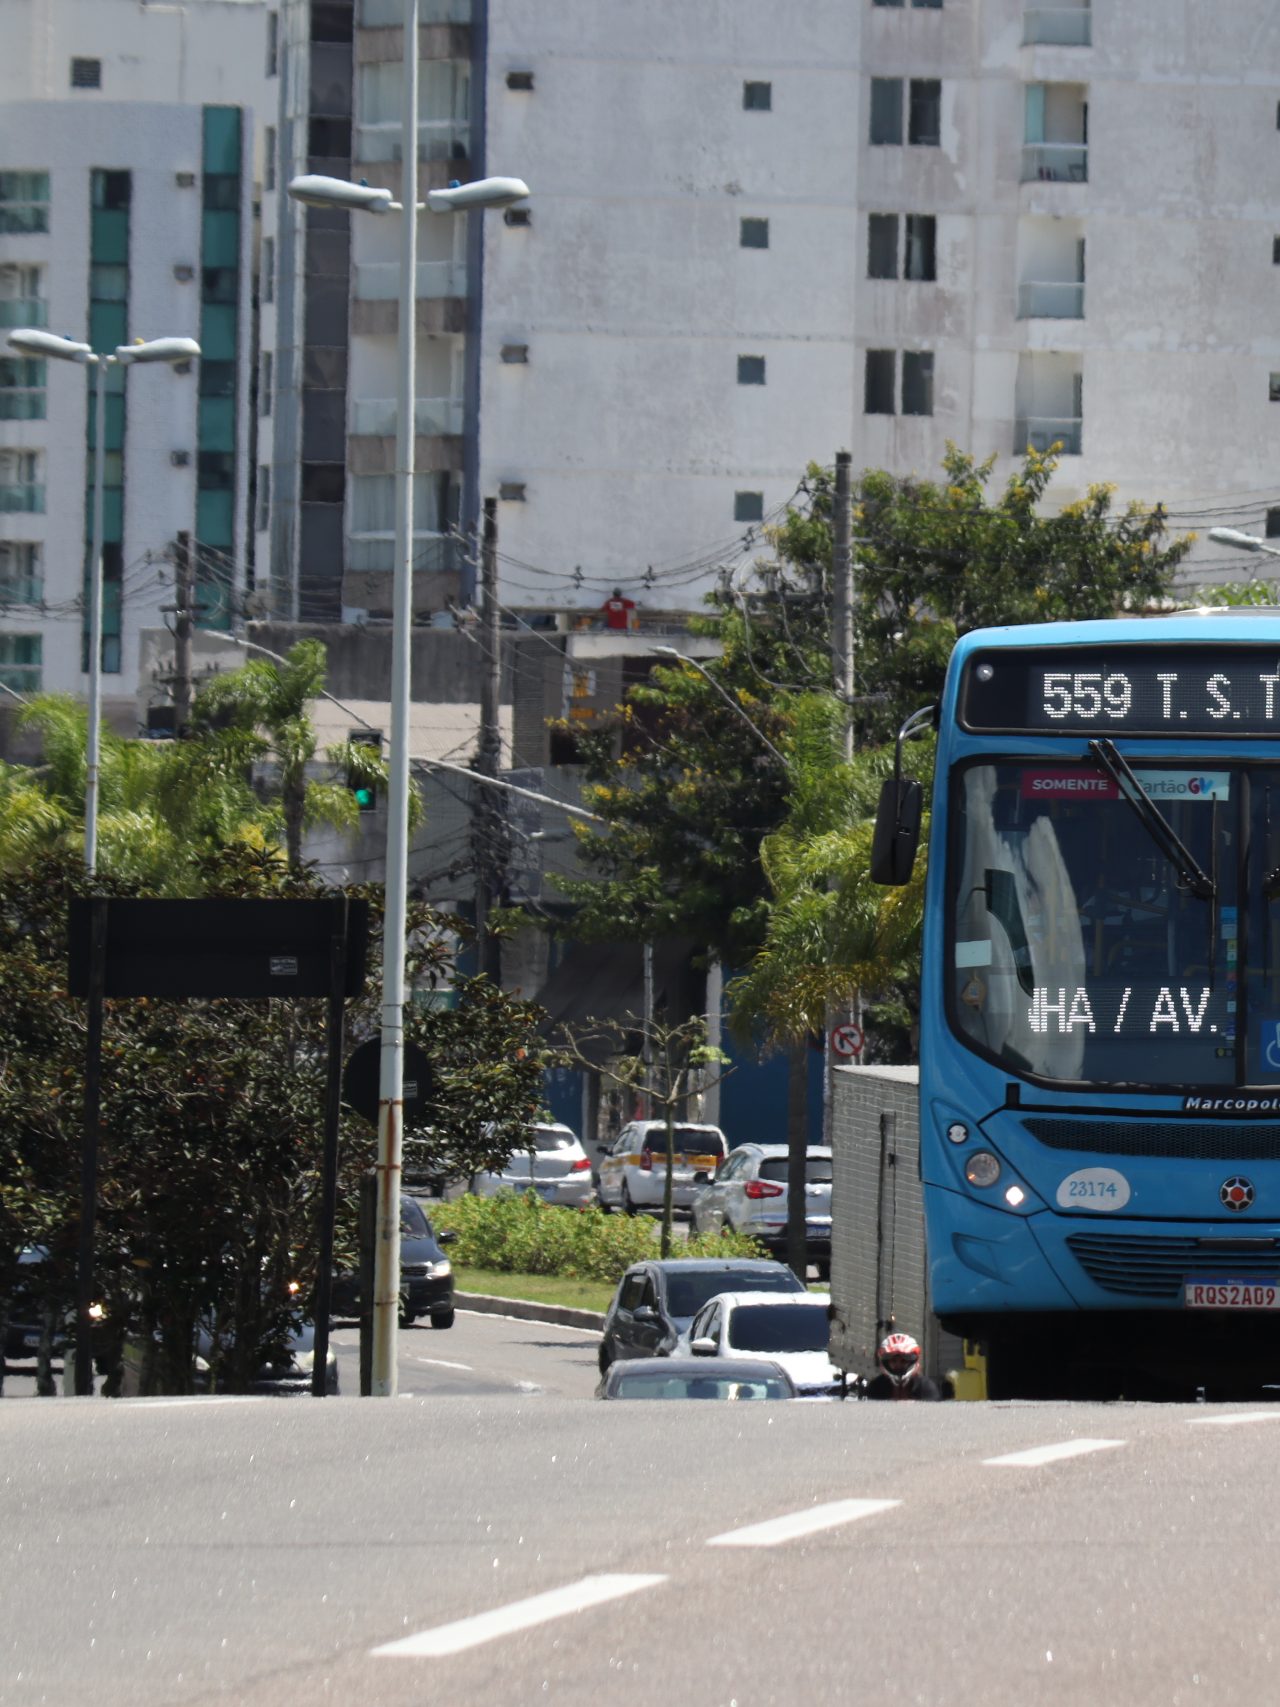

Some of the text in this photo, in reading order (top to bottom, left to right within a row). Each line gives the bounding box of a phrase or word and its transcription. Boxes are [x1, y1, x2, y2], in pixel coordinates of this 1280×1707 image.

[1043, 673, 1132, 719] 559
[1156, 673, 1188, 719] T.
[1206, 673, 1242, 719] S.
[1032, 779, 1108, 791] SOMENTE
[1114, 987, 1131, 1032] /
[1150, 987, 1217, 1032] AV.
[1069, 1181, 1118, 1197] 23174
[1194, 1286, 1276, 1306] RQS2A09
